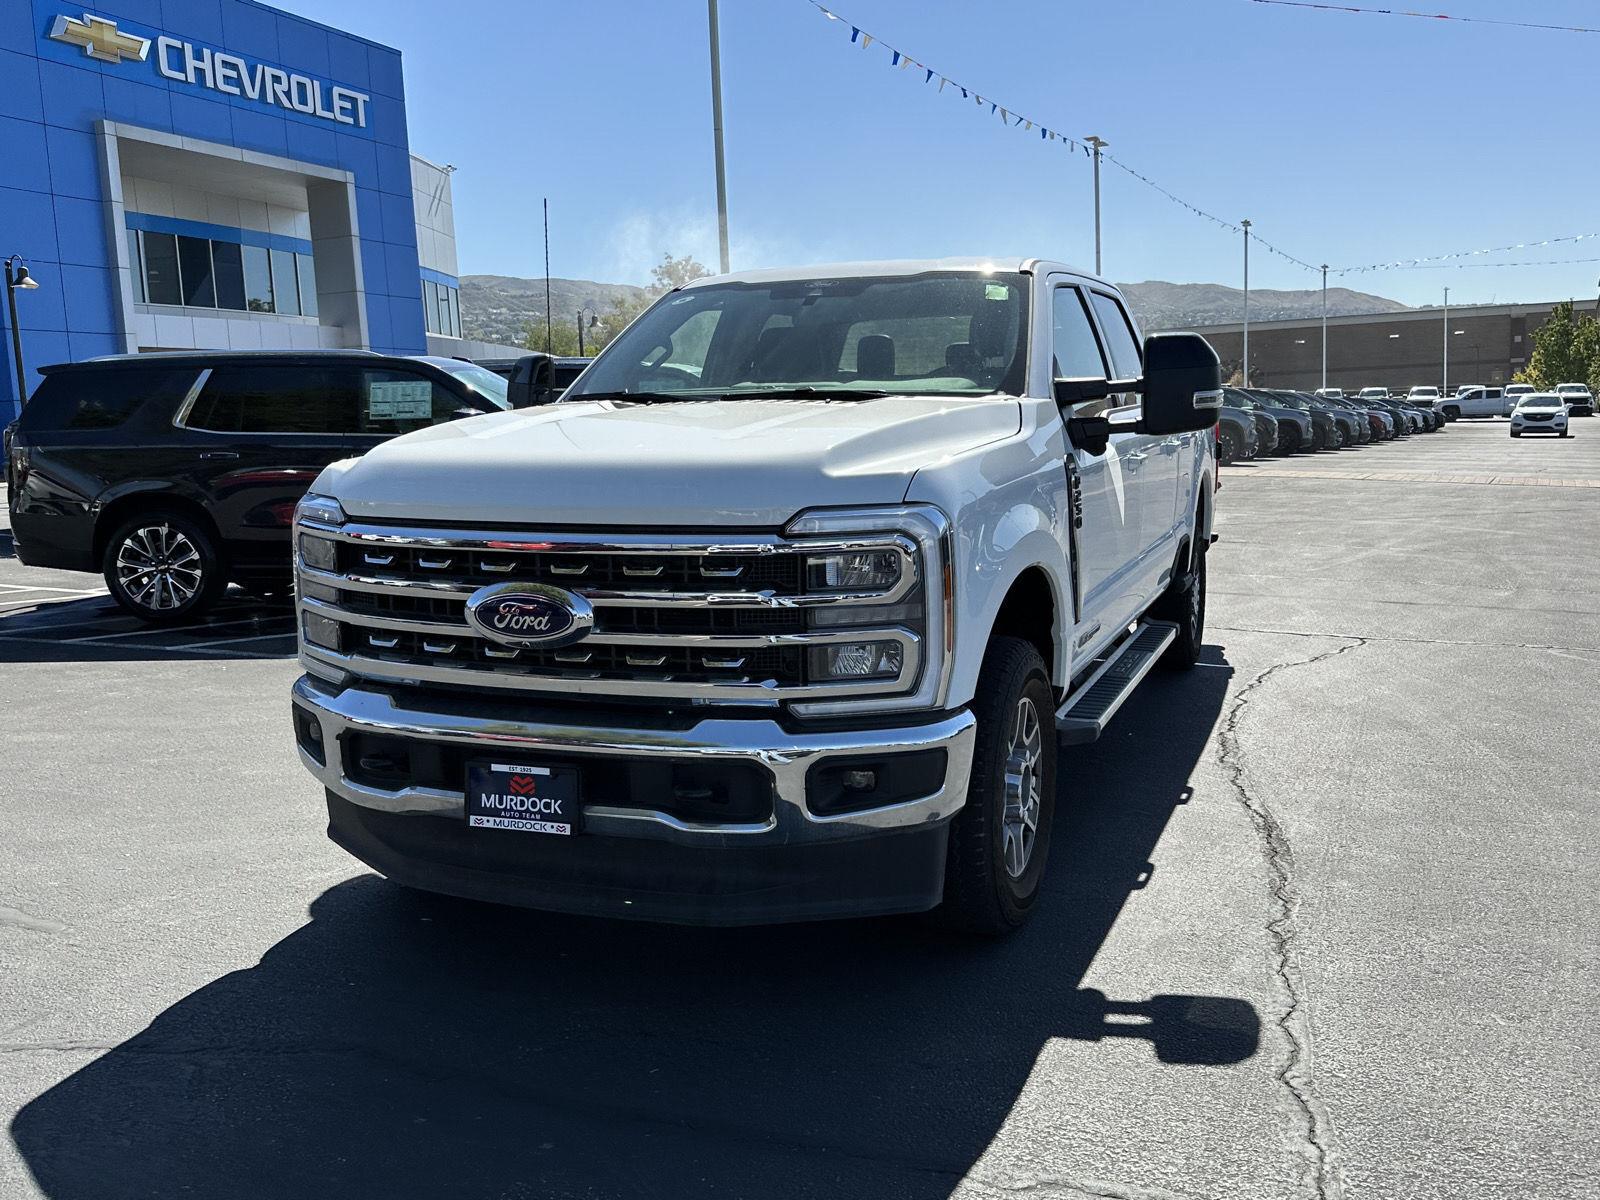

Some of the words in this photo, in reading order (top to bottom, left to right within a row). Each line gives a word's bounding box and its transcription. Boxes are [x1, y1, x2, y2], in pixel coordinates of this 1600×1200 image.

[157, 35, 370, 128] CHEVROLET
[494, 601, 551, 631] Ford
[481, 793, 563, 815] MURDOCK
[493, 818, 548, 832] MURDOCK
